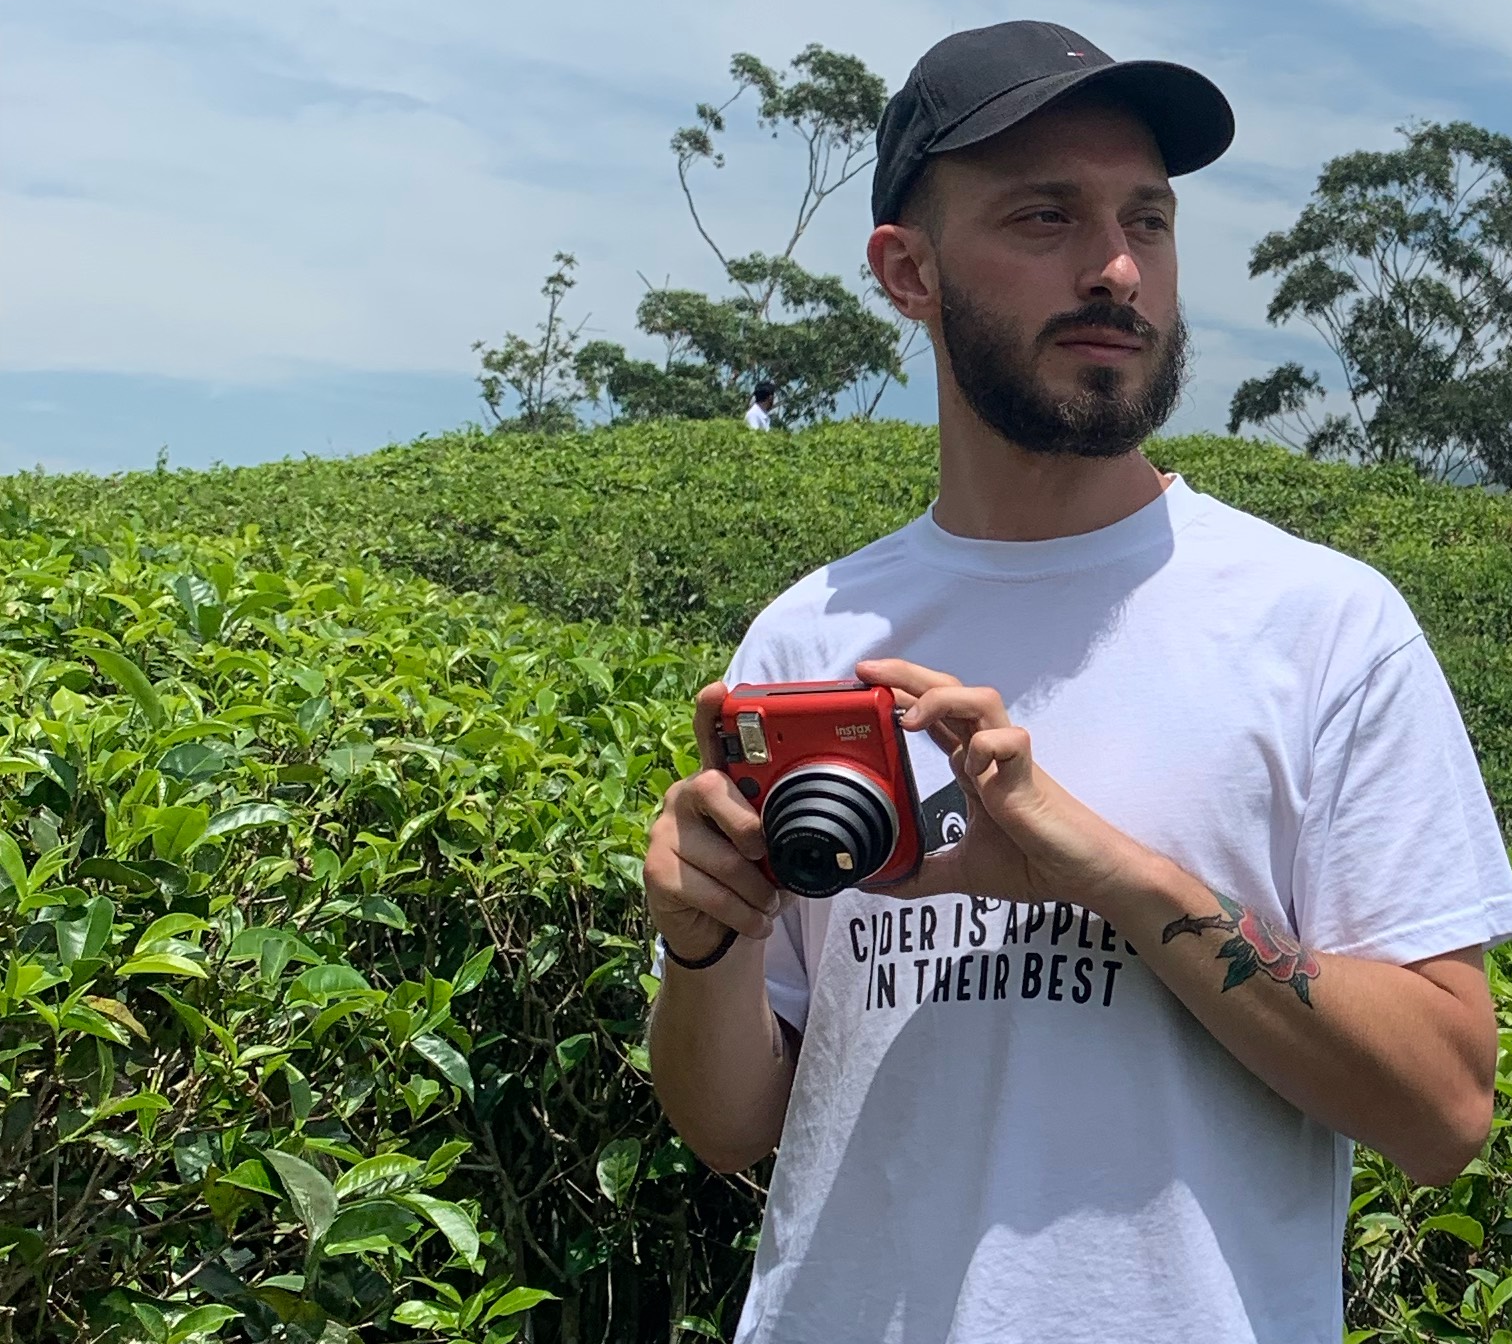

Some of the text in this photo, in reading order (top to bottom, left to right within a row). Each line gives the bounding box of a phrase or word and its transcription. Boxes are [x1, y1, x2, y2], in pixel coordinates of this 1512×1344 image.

[835, 724, 872, 736] instax
[849, 901, 1138, 963] CIDER IS APPLE
[913, 953, 1010, 1004] THEIR
[1021, 952, 1124, 1006] BEST
